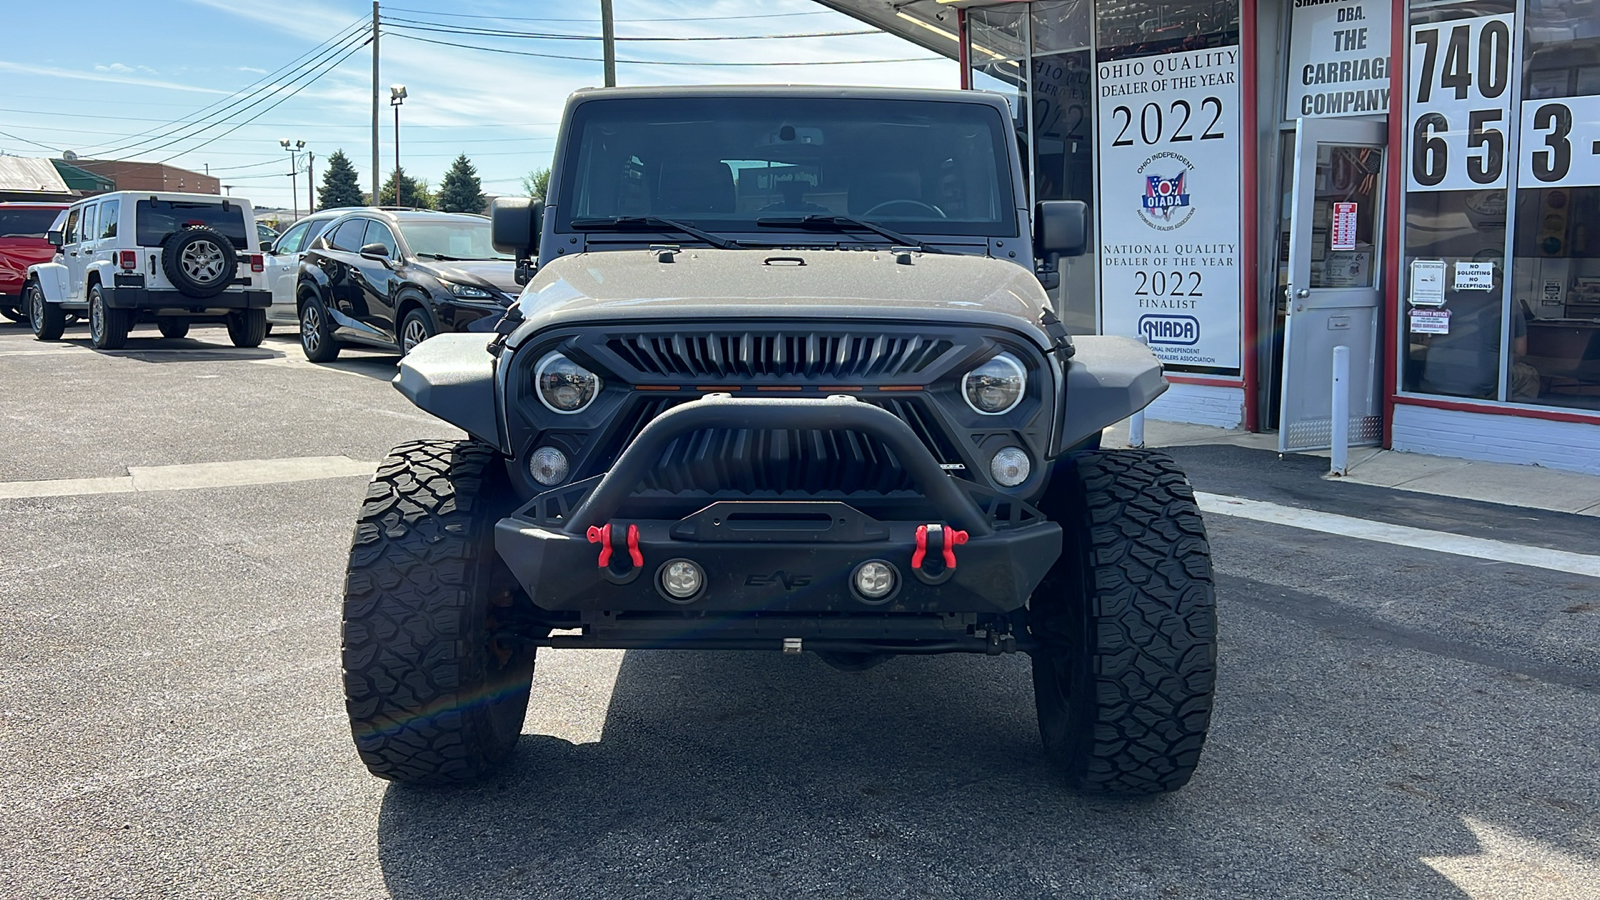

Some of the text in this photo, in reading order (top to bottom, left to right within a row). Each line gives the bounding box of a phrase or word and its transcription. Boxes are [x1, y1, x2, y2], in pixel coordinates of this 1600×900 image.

[1337, 6, 1366, 23] DBA.
[1333, 28, 1367, 52] THE
[1100, 62, 1145, 80] OHIO
[1153, 50, 1238, 76] QUALITY
[1415, 20, 1509, 103] 740
[1101, 82, 1148, 97] DEALER
[1151, 79, 1168, 92] OF
[1171, 76, 1196, 89] THE
[1200, 71, 1235, 87] YEAR
[1301, 88, 1390, 116] COMPANY
[1112, 97, 1224, 147] 2022
[1137, 151, 1195, 174] OHIO INDEPENDENT
[1147, 195, 1182, 207] OIADA
[1175, 207, 1196, 229] ASSOCIATION
[1104, 244, 1235, 255] NATIONAL QUALITY
[1105, 257, 1234, 267] DEALER OF THE YEAR
[1134, 271, 1203, 296] 2022
[1139, 299, 1197, 309] FINALIST
[1143, 321, 1193, 339] NIADA
